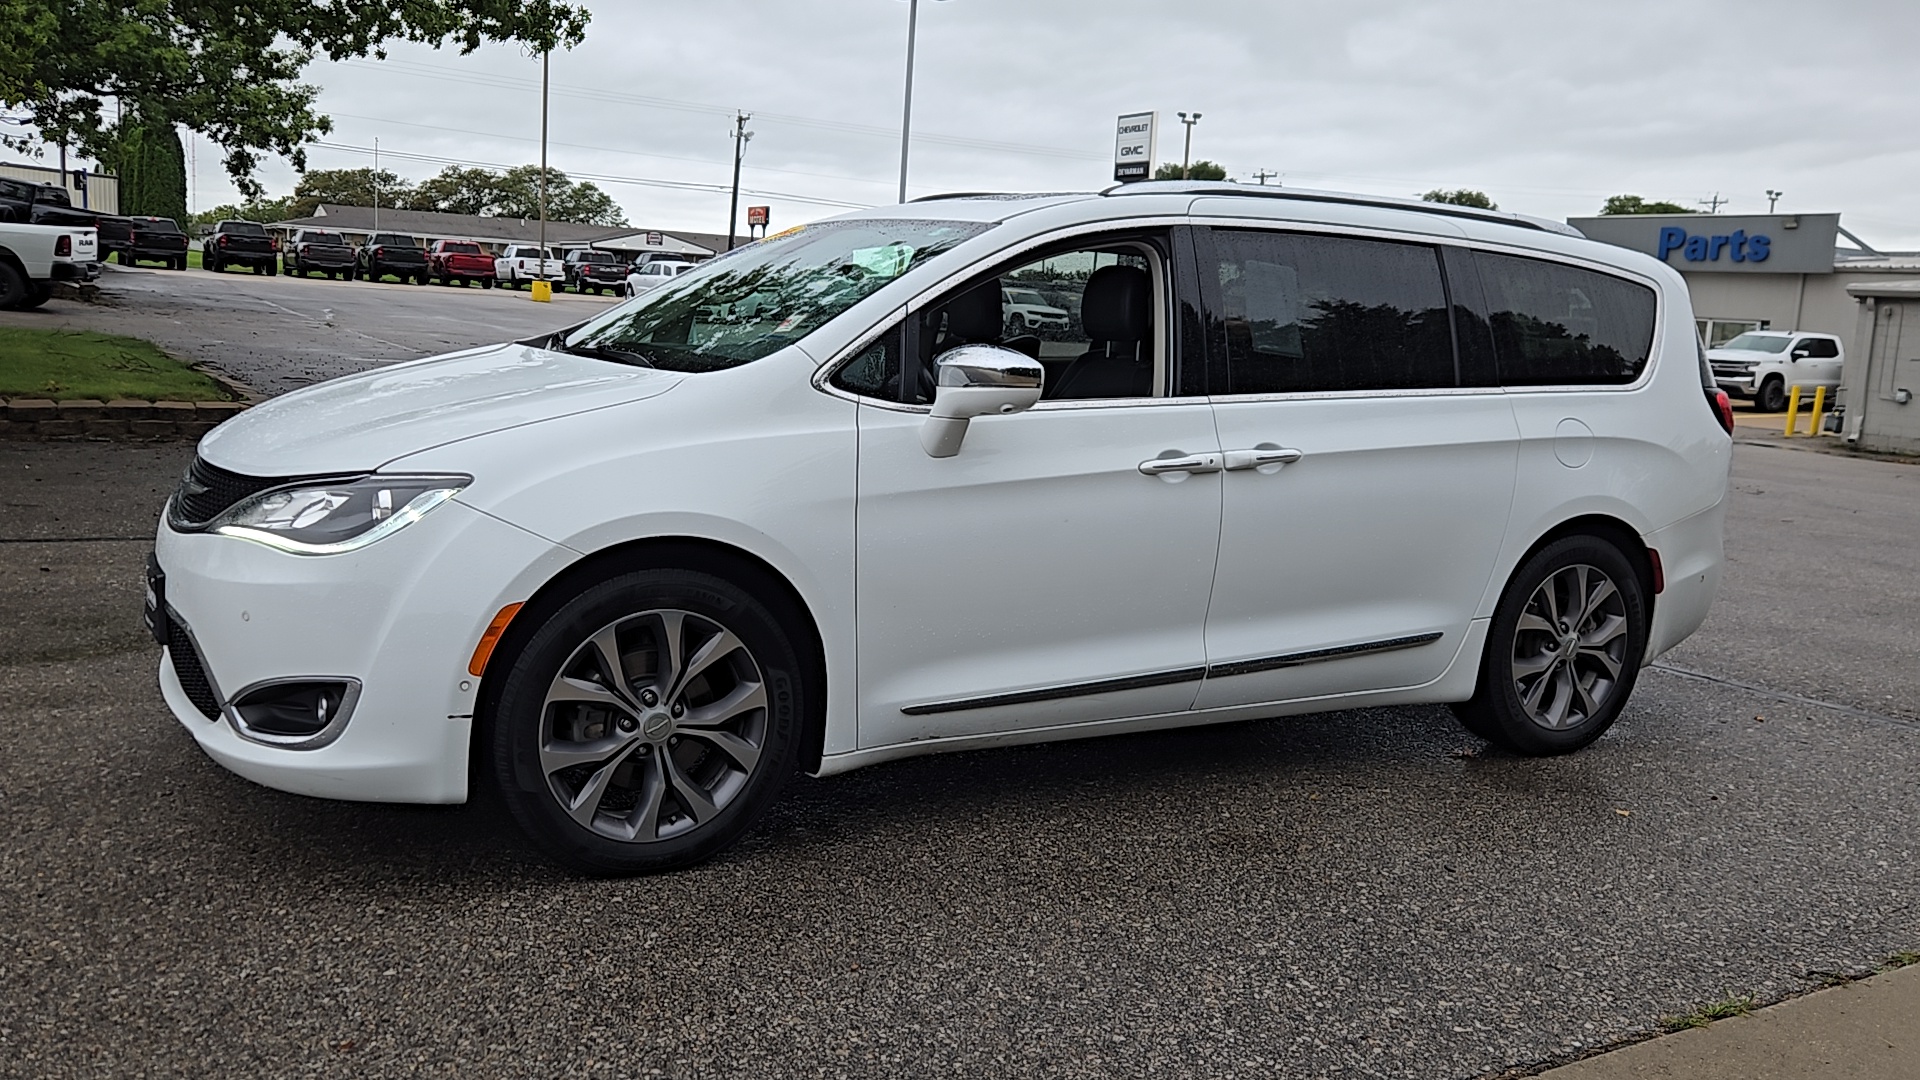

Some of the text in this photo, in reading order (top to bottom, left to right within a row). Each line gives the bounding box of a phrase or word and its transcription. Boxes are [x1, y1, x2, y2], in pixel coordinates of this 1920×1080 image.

[1118, 123, 1149, 135] CHEVROLET
[1120, 145, 1144, 156] GMC
[749, 215, 766, 224] MOTEL
[78, 239, 94, 247] RAM
[1658, 226, 1771, 262] Parts
